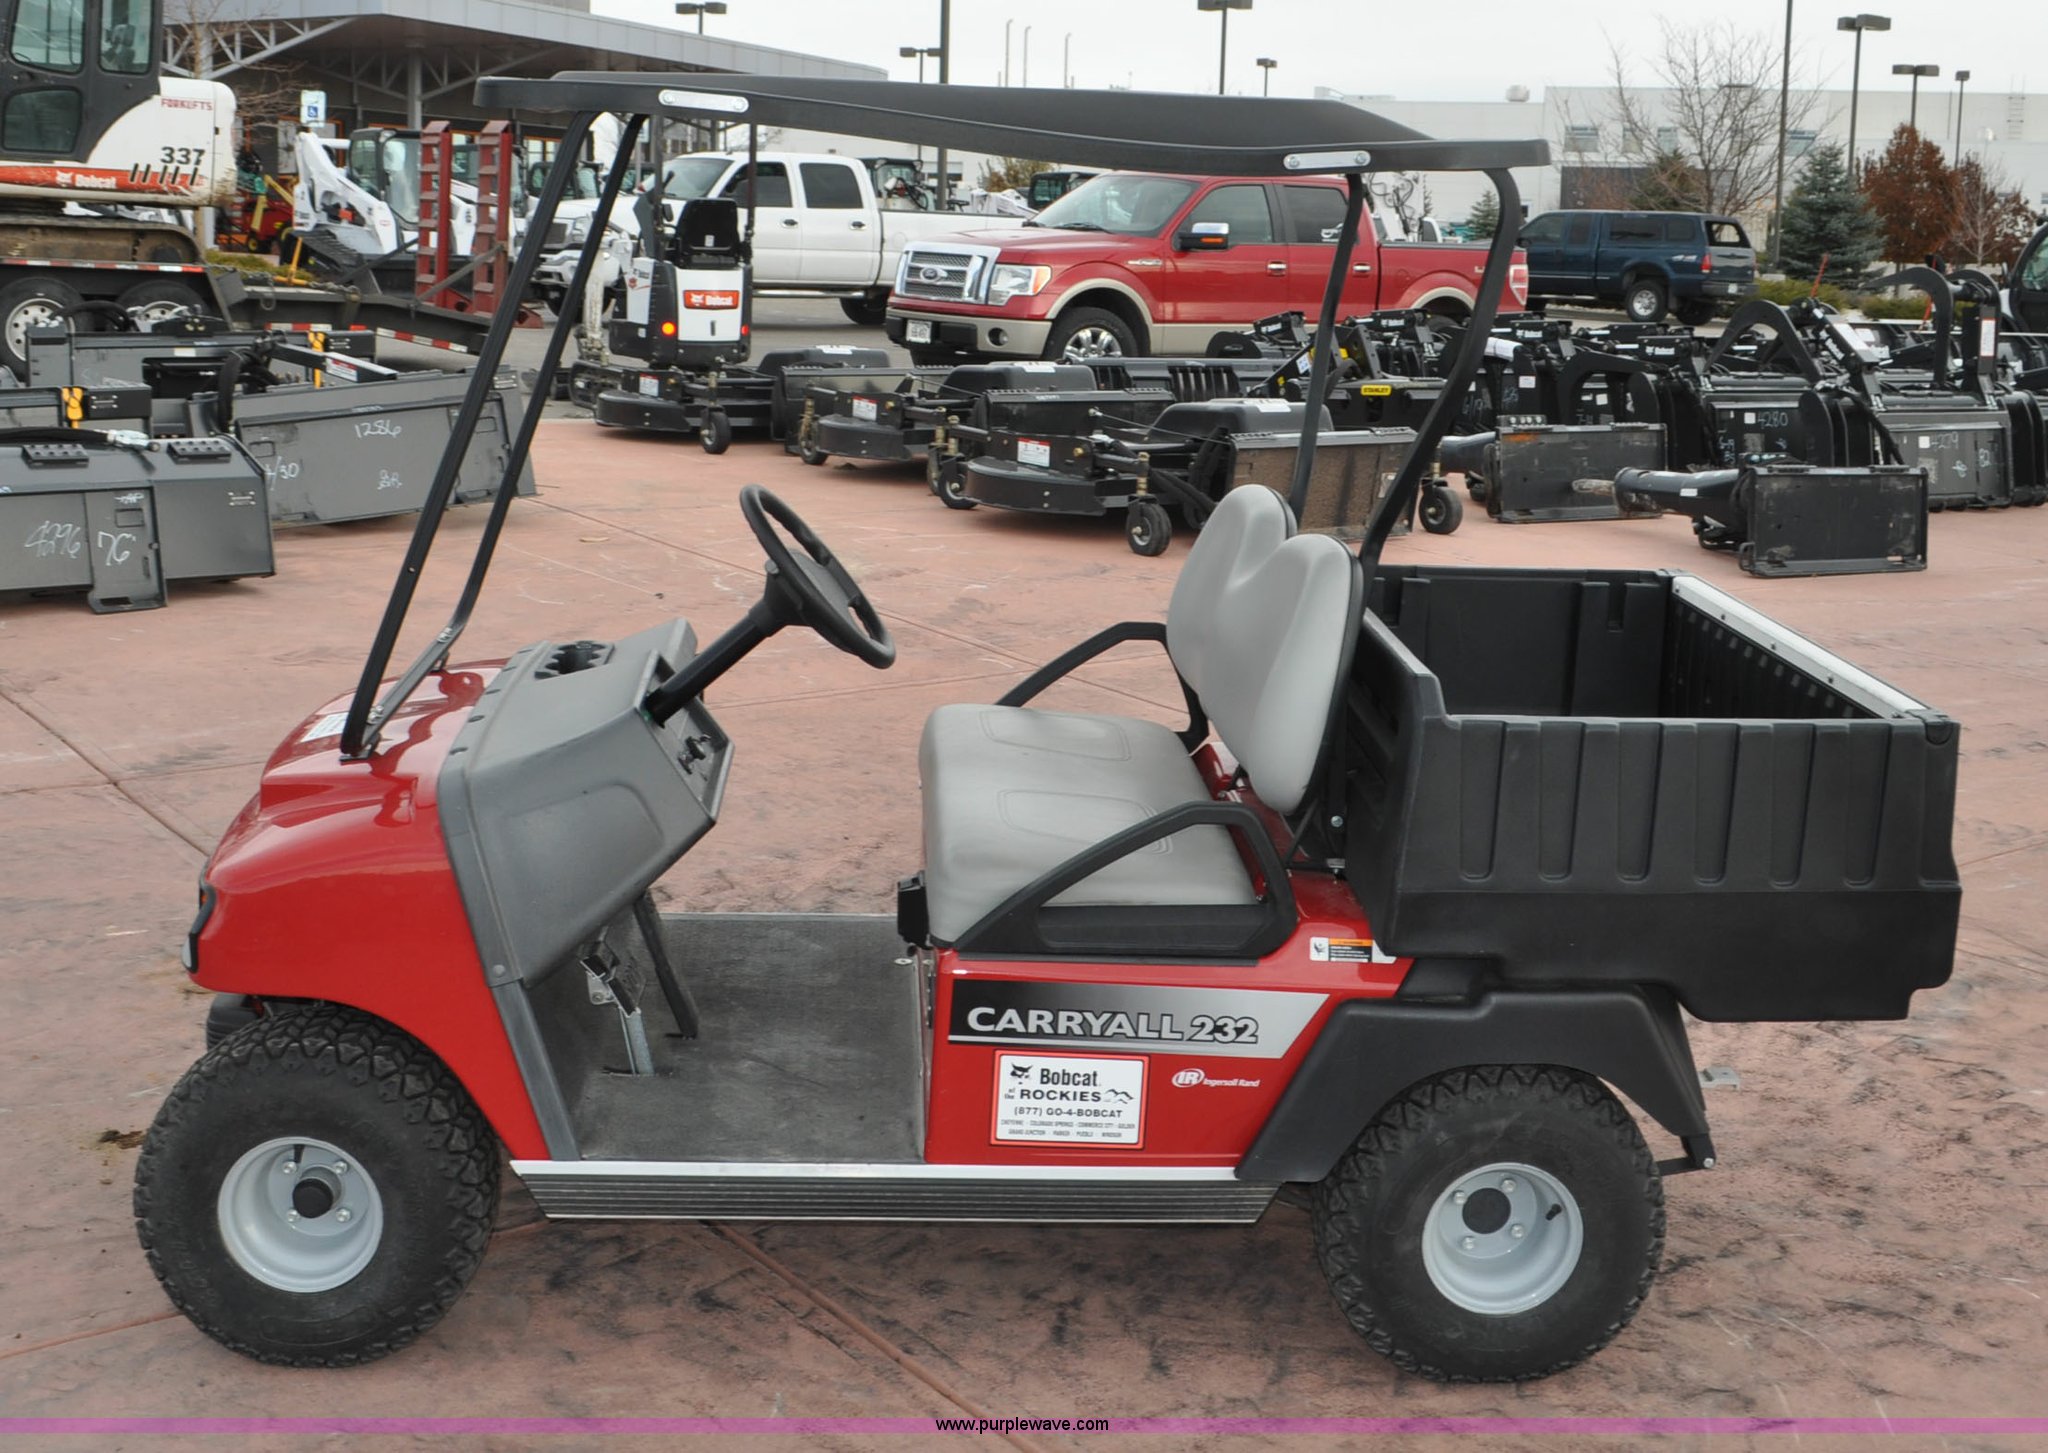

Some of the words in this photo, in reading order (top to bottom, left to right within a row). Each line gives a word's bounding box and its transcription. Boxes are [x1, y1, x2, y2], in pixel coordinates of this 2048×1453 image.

[161, 146, 205, 166] 337
[1362, 386, 1389, 394] STANLEY
[967, 1007, 1184, 1041] CARRYALL
[1187, 1014, 1260, 1044] 232
[1040, 1068, 1099, 1087] Bobcat
[1176, 1070, 1202, 1086] IR
[1020, 1089, 1102, 1102] ROCKIES
[1014, 1106, 1043, 1117] (877)
[1046, 1107, 1123, 1118] GO-4-BOBCAT
